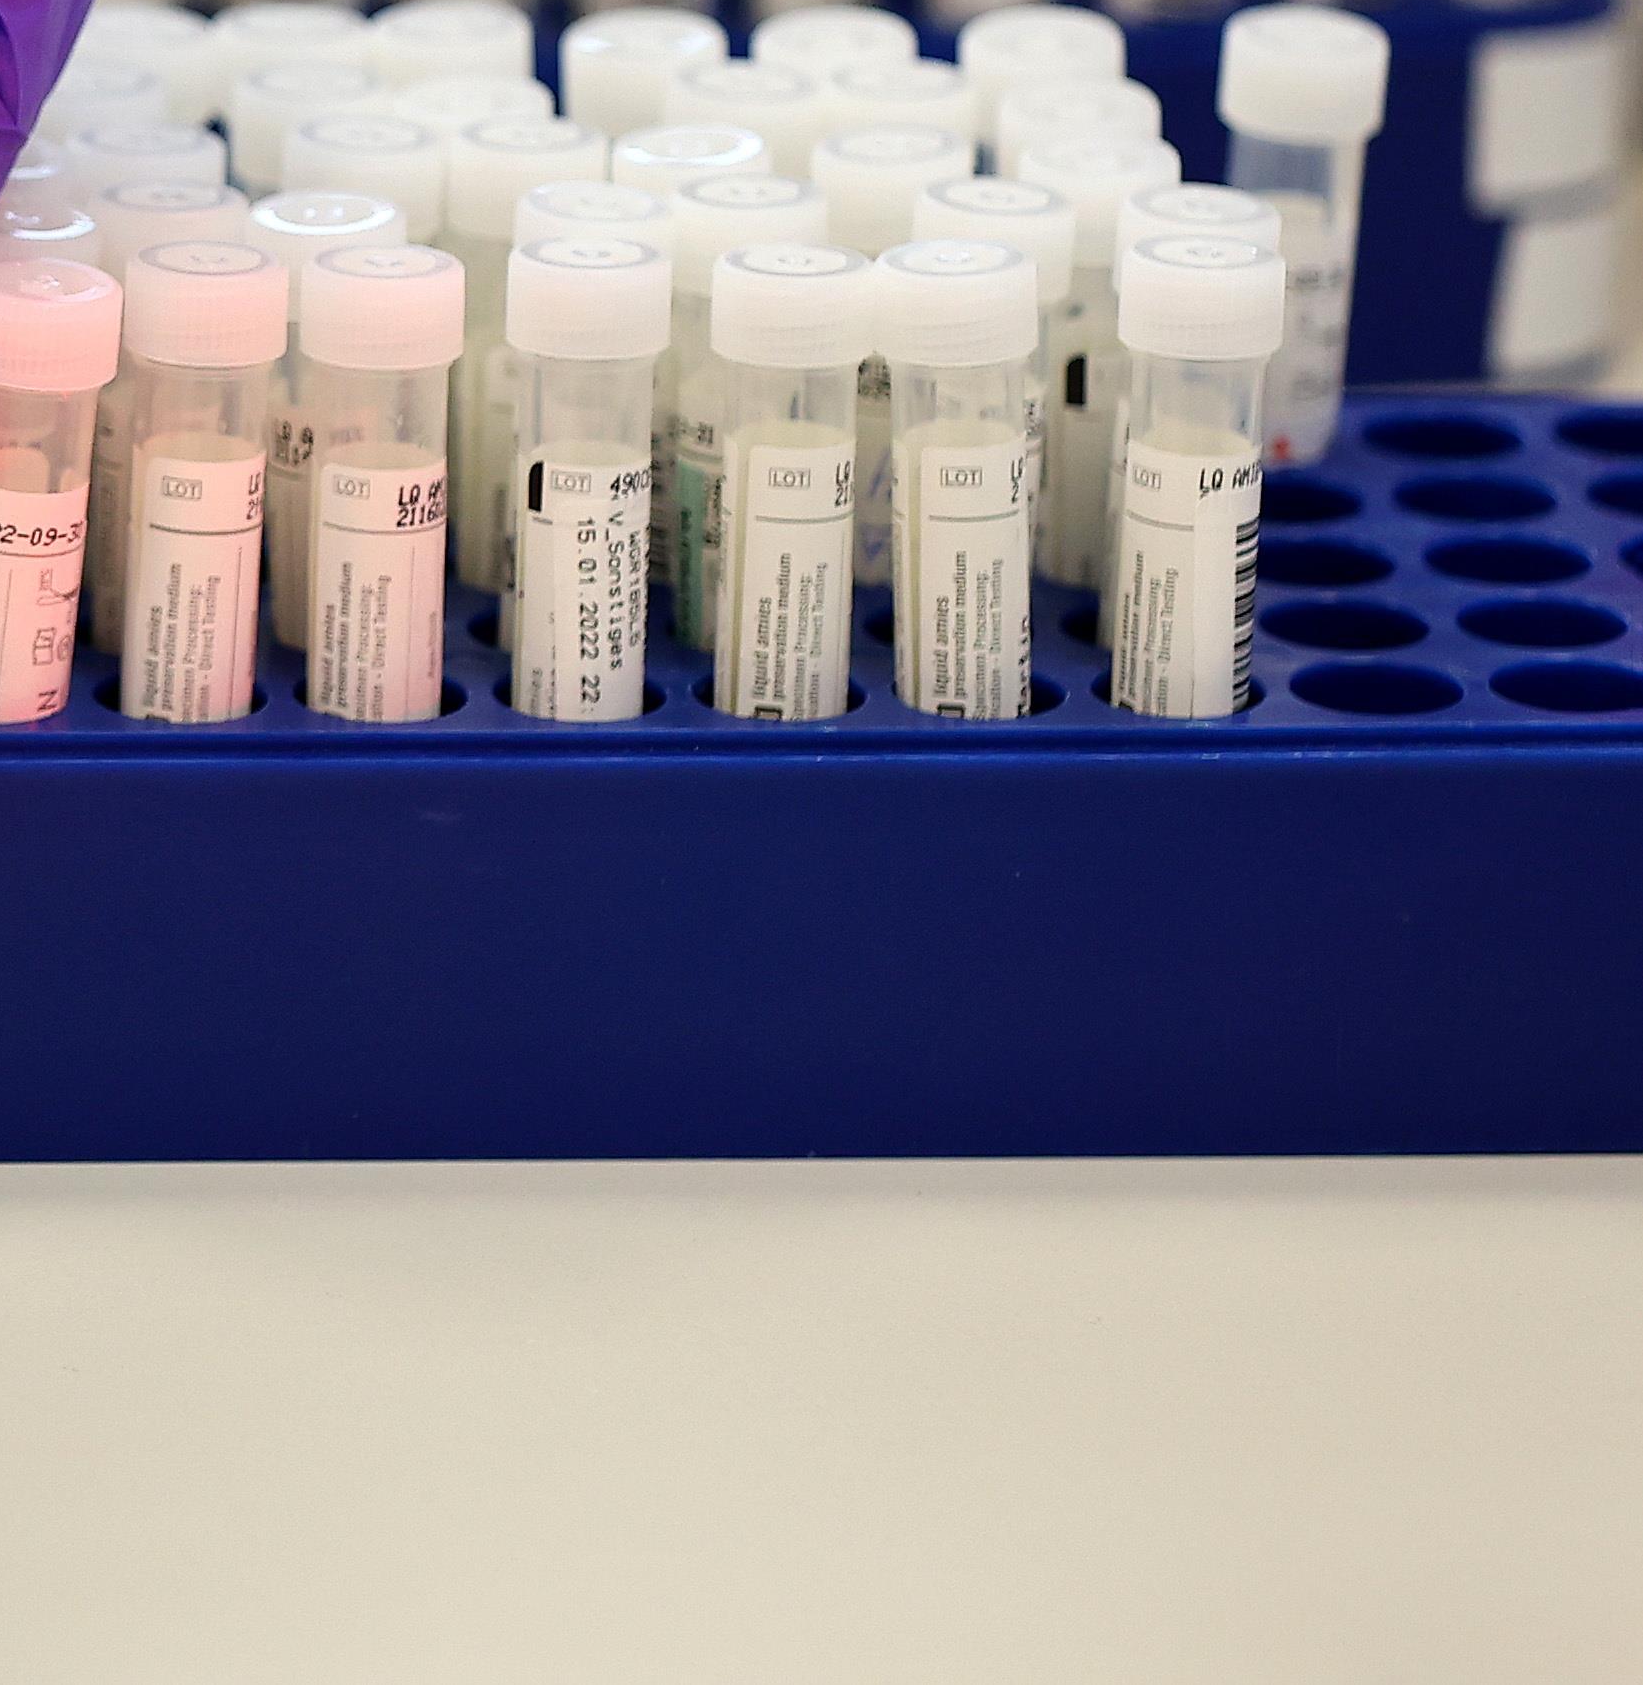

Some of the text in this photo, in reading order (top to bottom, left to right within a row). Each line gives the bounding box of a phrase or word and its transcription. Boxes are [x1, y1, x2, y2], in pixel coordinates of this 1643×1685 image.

[555, 474, 588, 492] LOT
[772, 470, 804, 488] LOT
[945, 468, 979, 487] LOT
[1134, 468, 1161, 490] LOT
[577, 517, 600, 660] 15.01.2022
